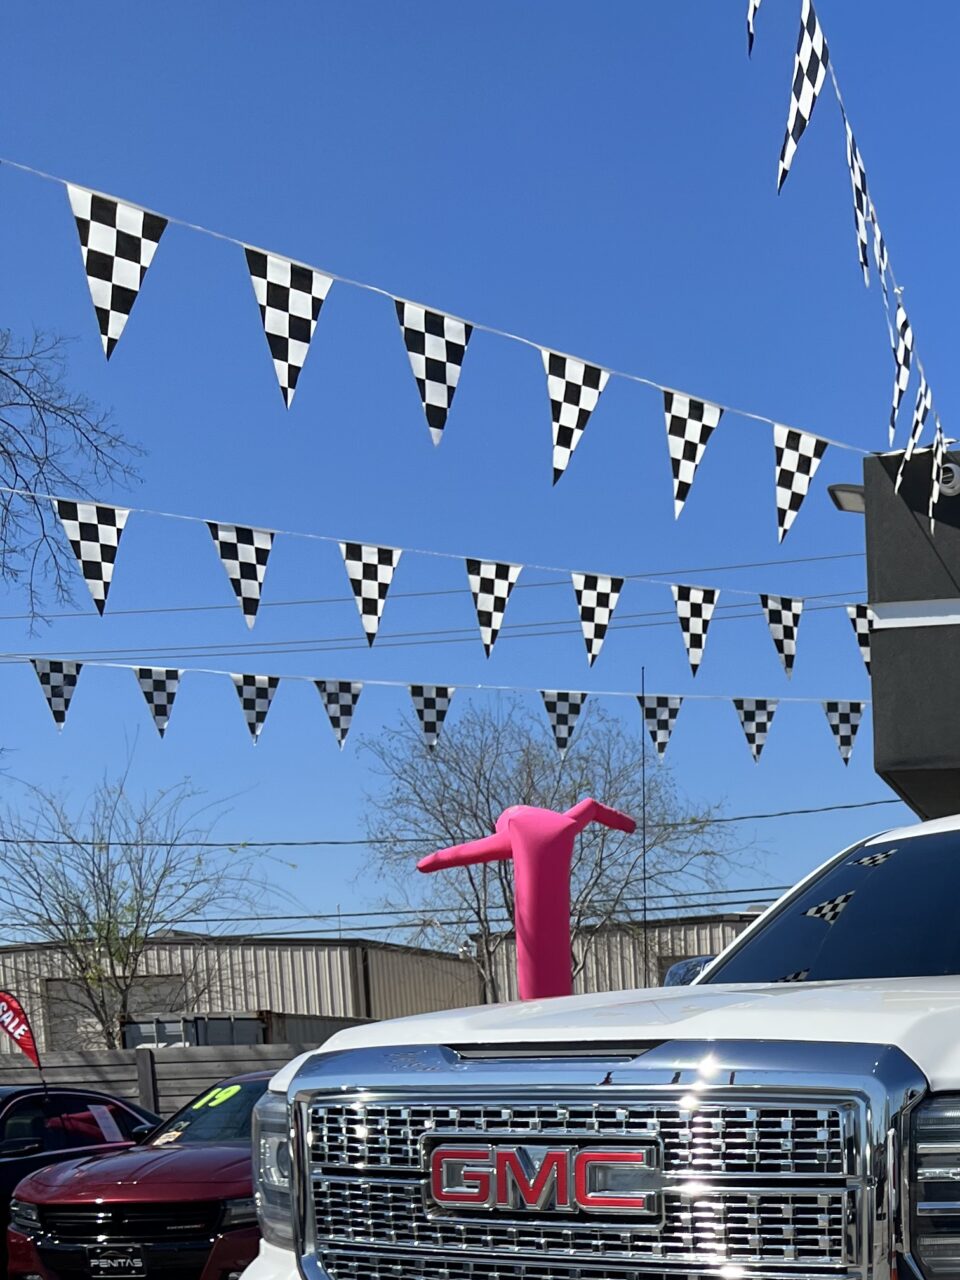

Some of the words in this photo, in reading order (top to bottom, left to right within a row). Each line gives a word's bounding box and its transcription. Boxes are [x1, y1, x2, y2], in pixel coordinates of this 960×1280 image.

[192, 1085, 241, 1109] 19
[431, 1145, 656, 1214] GMC
[89, 1258, 143, 1268] PENITAS
